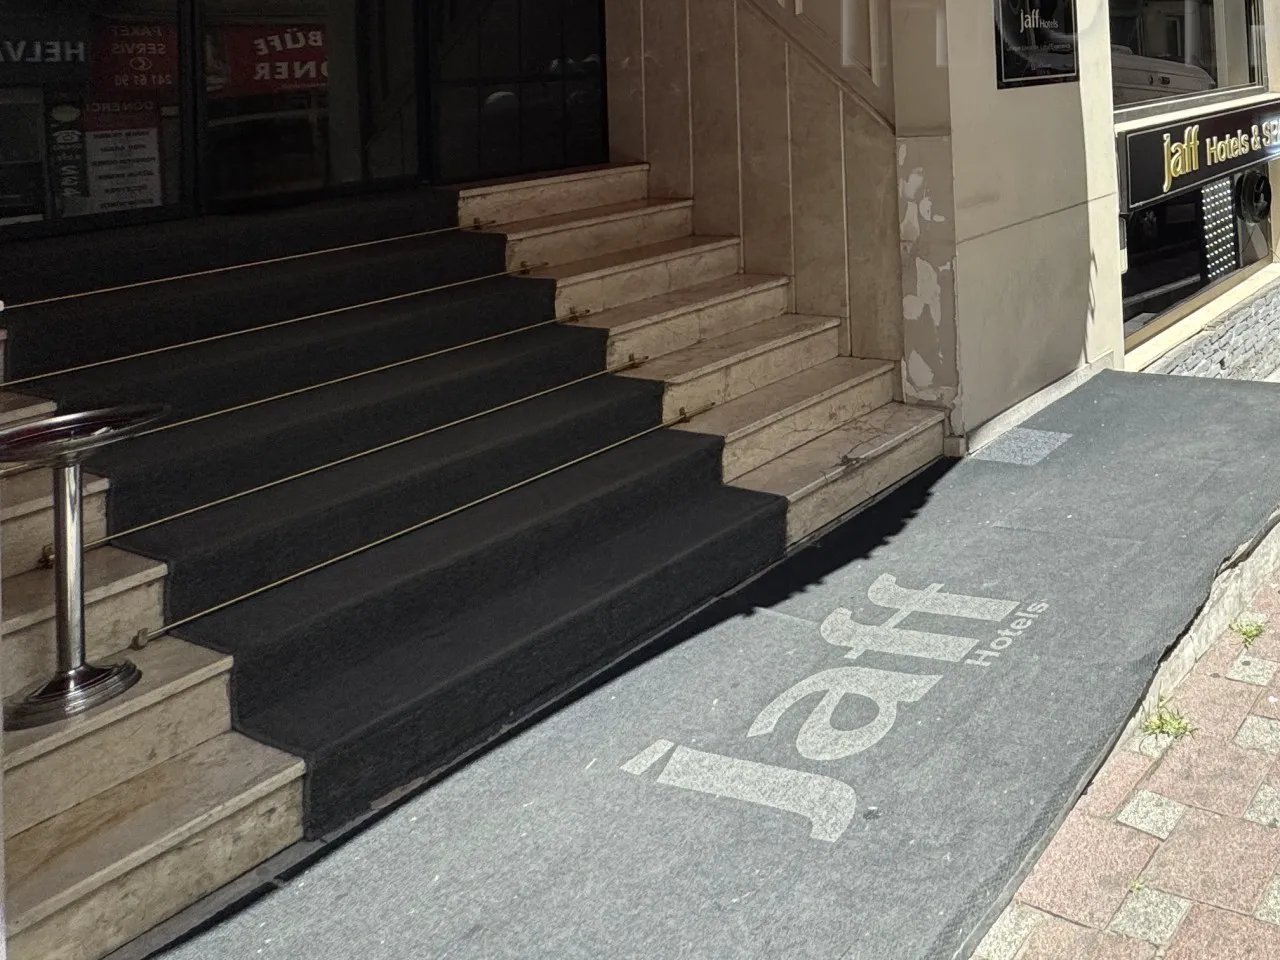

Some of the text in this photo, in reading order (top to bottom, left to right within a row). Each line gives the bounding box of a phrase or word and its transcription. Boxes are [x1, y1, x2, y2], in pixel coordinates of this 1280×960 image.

[1039, 17, 1059, 29] Hotels
[1205, 129, 1250, 166] Hotels
[1250, 124, 1262, 151] &
[965, 598, 1050, 667] Hotels
